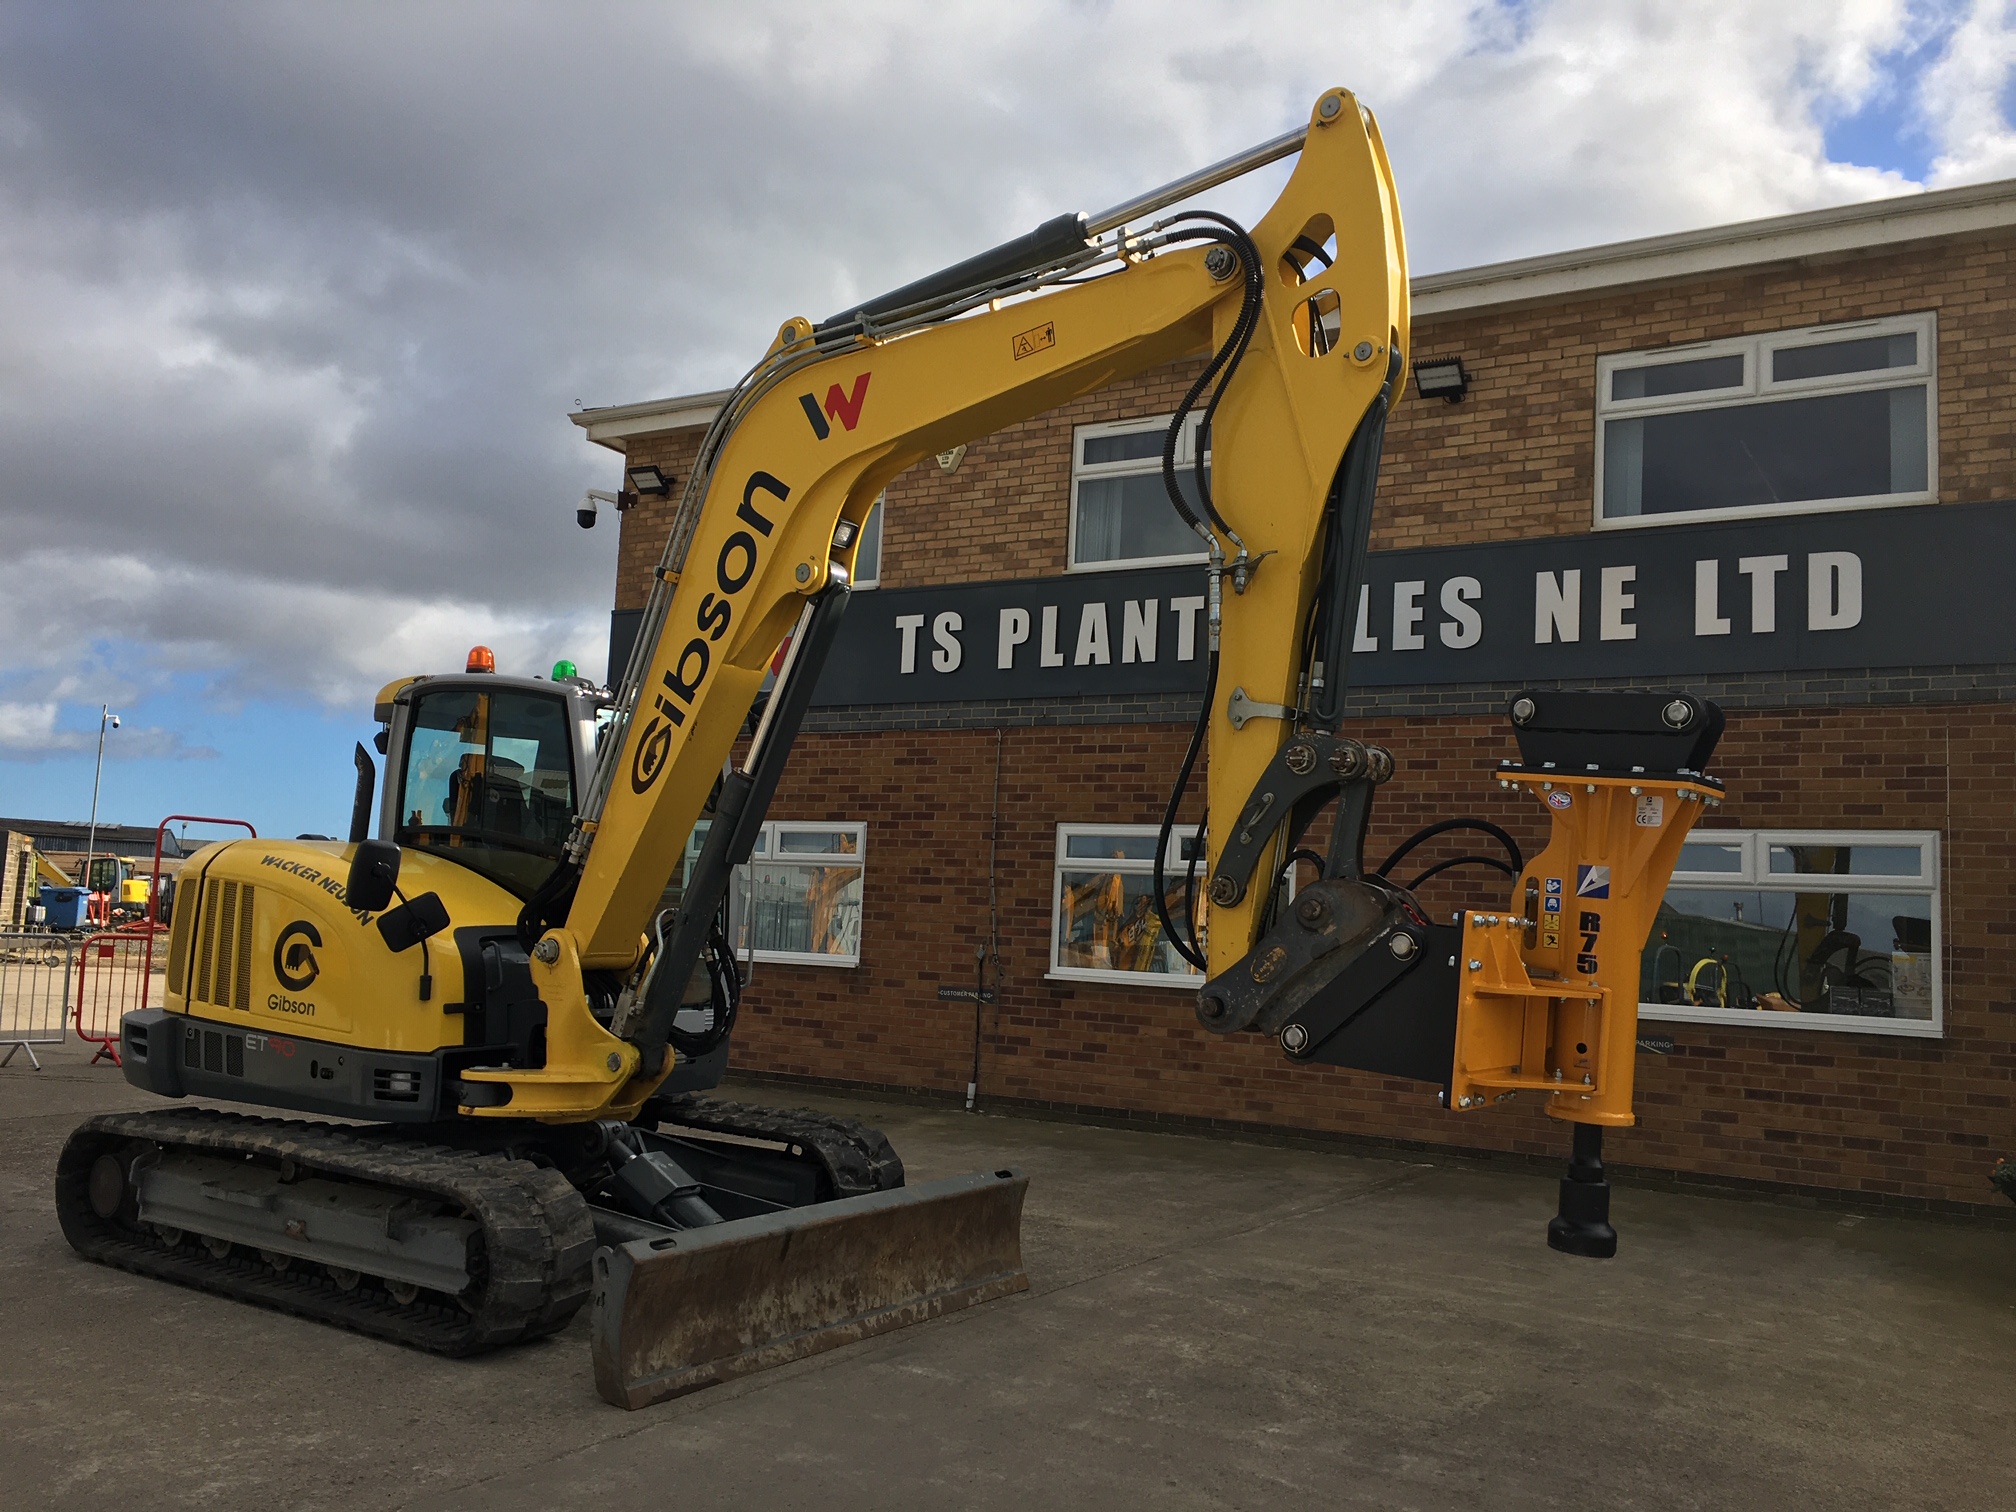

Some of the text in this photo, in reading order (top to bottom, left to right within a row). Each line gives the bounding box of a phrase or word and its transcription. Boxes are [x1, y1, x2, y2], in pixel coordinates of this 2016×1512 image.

[631, 470, 791, 795] Gibson
[896, 551, 1863, 674] TS PLANT LES NE LTD
[260, 855, 322, 883] WACKER
[1577, 911, 1601, 974] R75
[267, 994, 315, 1016] Gibson
[246, 1033, 296, 1057] ET90
